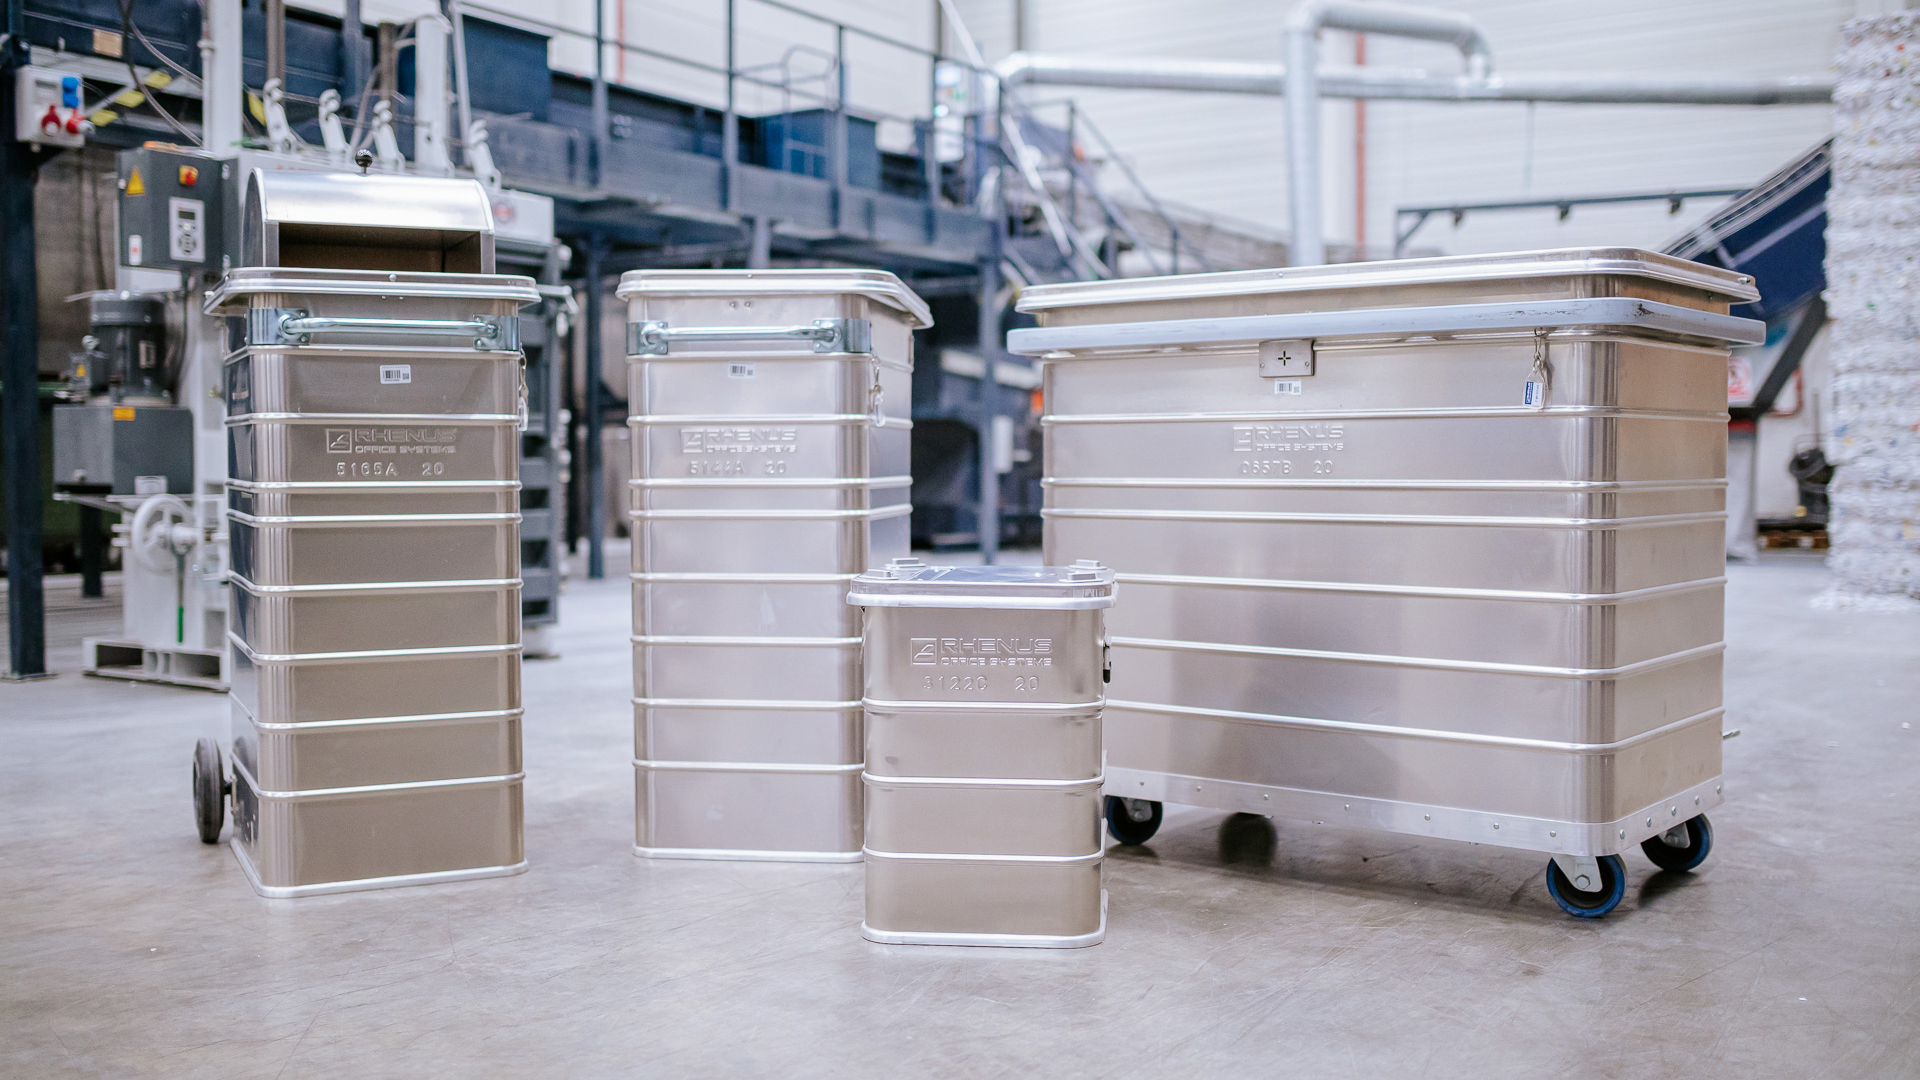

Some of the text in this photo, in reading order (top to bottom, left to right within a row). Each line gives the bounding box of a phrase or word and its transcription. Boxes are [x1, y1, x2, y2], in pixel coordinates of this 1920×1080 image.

[354, 428, 457, 443] RHENUS
[706, 427, 797, 442] RHENUS
[1256, 425, 1344, 440] RHENUS
[355, 445, 457, 454] OFFICE SYSTEMS
[336, 461, 445, 477] 5165A 20
[765, 460, 787, 474] 20
[1313, 459, 1334, 474] 20
[940, 637, 1053, 654] RHENUS
[940, 656, 1053, 667] OFFICE SYSTEMS
[1015, 675, 1040, 691] 20
